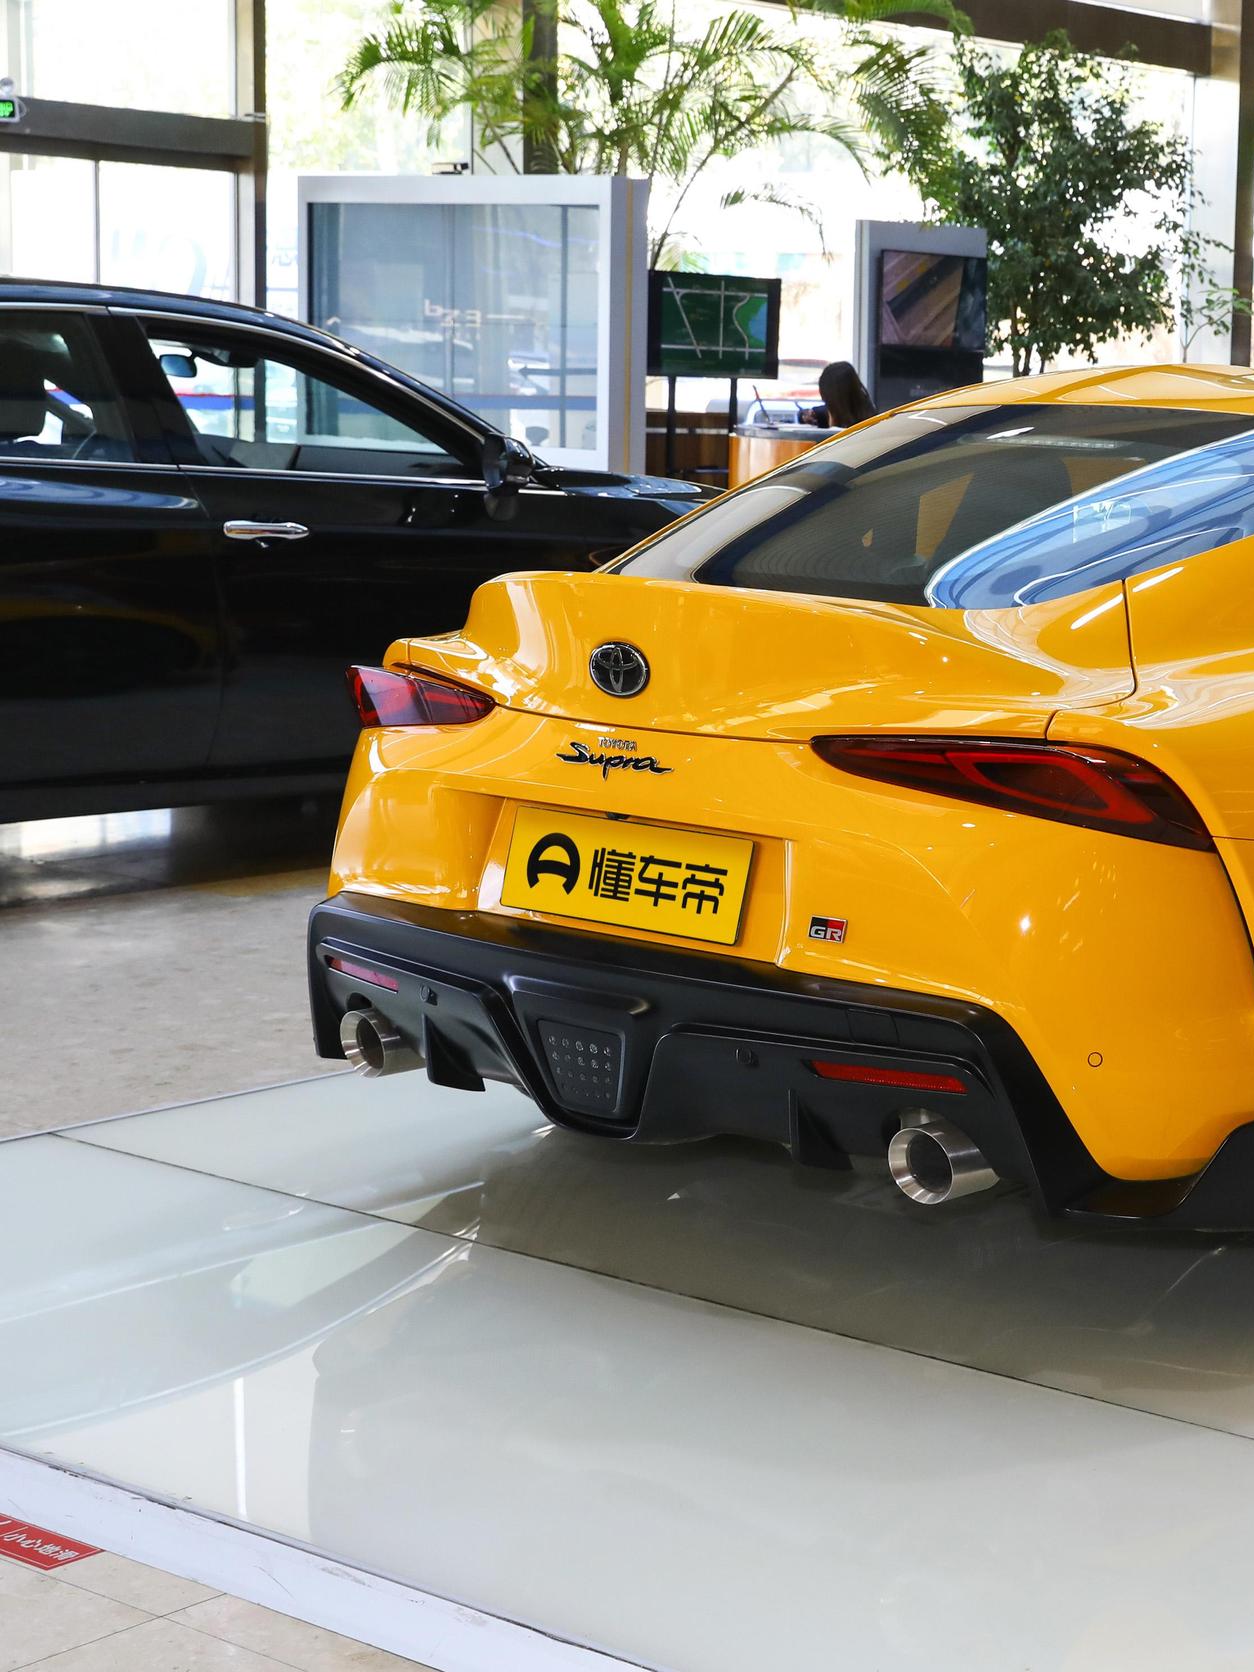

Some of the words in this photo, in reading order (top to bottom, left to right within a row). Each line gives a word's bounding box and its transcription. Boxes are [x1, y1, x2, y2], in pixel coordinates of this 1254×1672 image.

[597, 736, 637, 751] TOYOTA
[555, 741, 673, 780] Supra
[588, 847, 728, 914] 懂车帝
[810, 925, 843, 941] GR
[3, 1532, 80, 1561] 小心地滑
